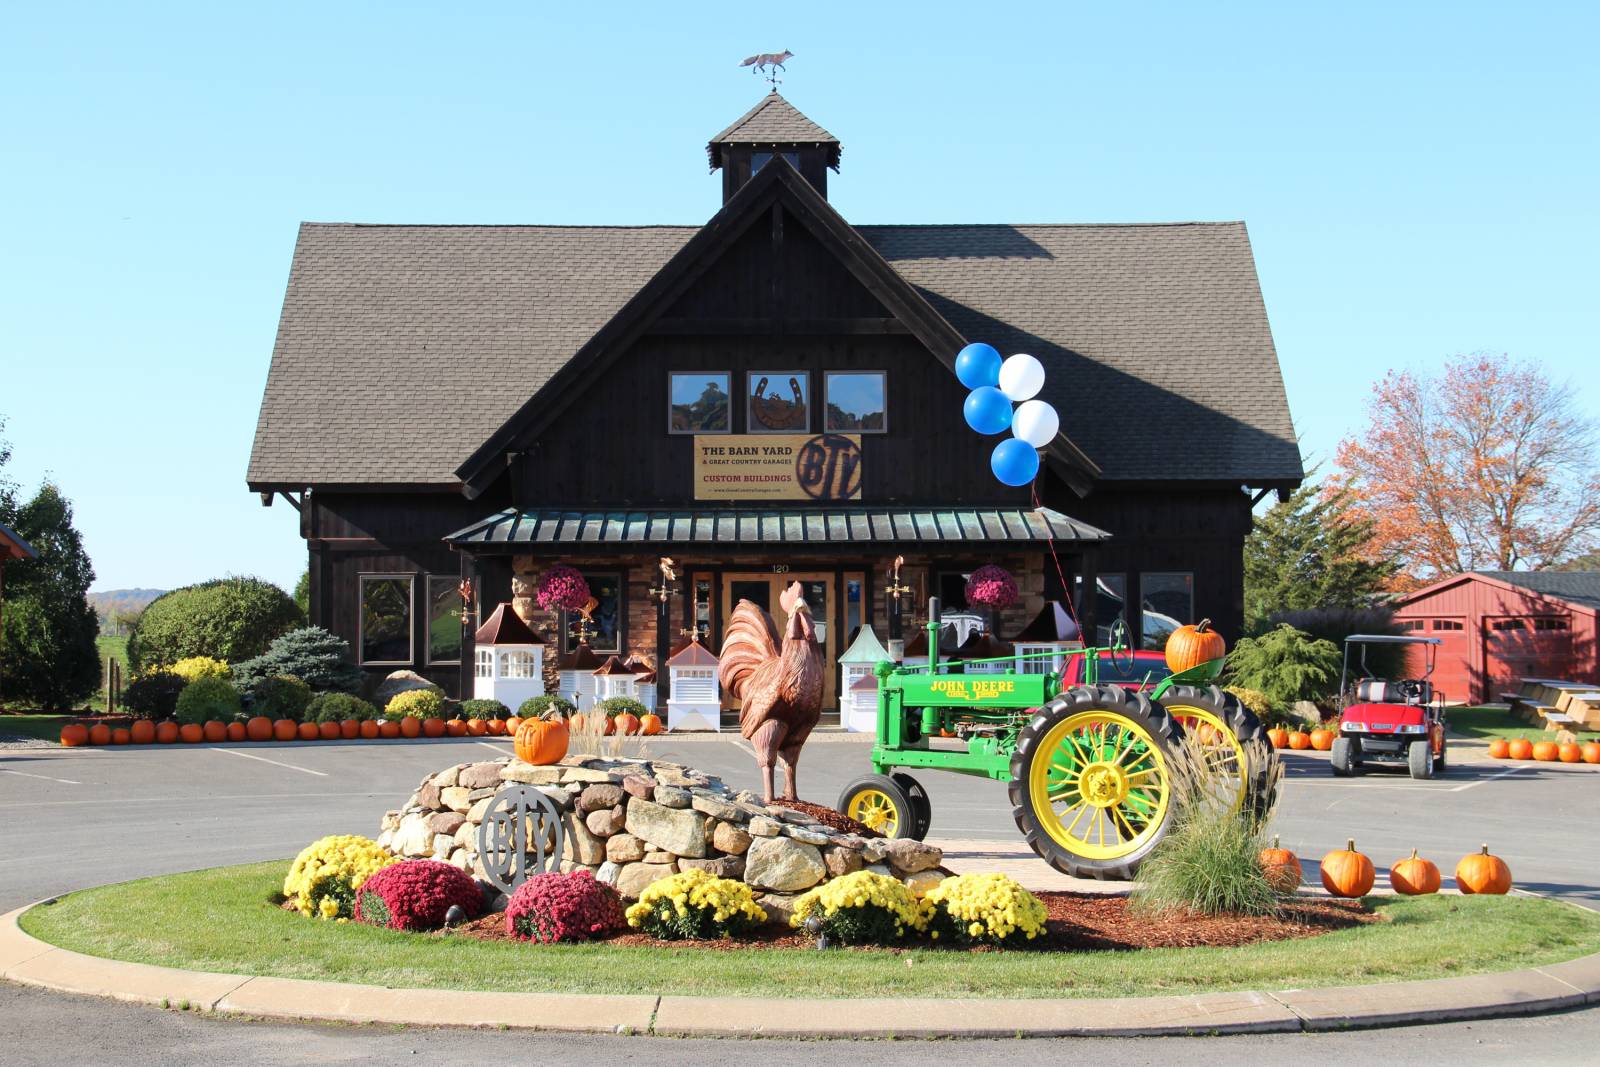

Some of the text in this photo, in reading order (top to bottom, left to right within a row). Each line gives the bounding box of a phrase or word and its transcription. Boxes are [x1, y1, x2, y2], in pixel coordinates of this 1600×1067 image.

[702, 447, 793, 456] THE BARN YARD
[773, 564, 790, 573] 120
[930, 681, 1015, 692] JOHN DEERE
[491, 786, 558, 888] BTY
